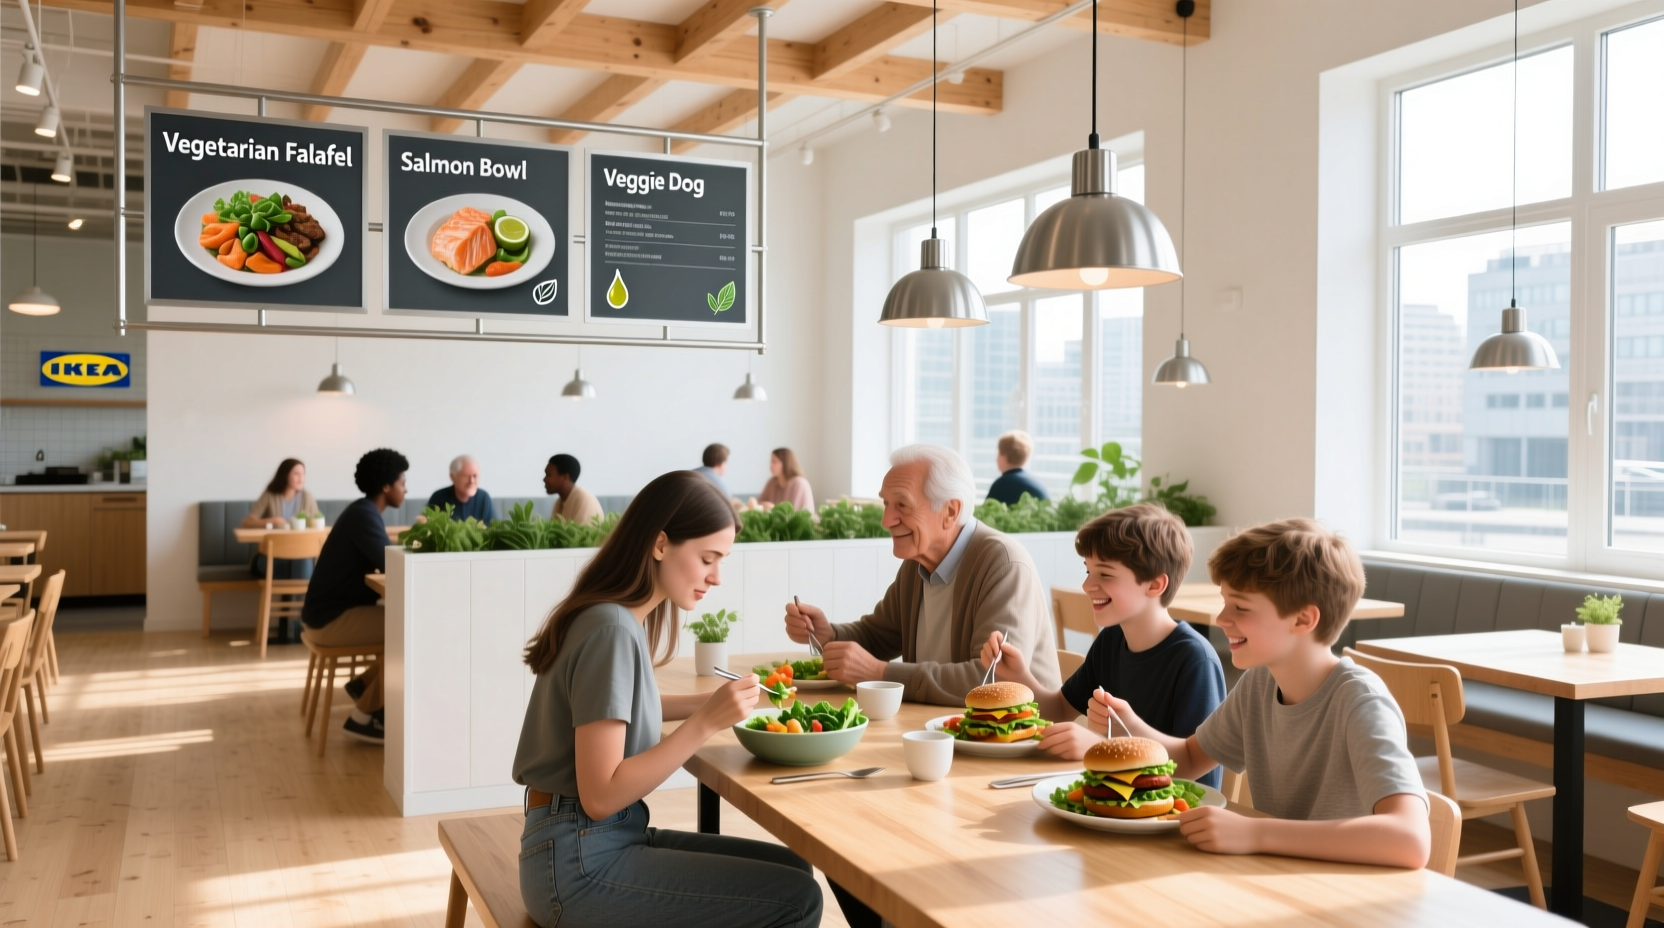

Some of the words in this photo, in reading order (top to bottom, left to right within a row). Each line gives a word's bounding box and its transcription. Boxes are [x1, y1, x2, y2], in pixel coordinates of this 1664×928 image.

[162, 131, 279, 161] Vegetarian
[285, 141, 353, 167] Falafel
[400, 151, 475, 176] Salmon
[479, 157, 527, 180] Bowl
[603, 167, 665, 195] Veggie
[669, 172, 705, 199] Dog
[50, 362, 122, 377] IKEA
